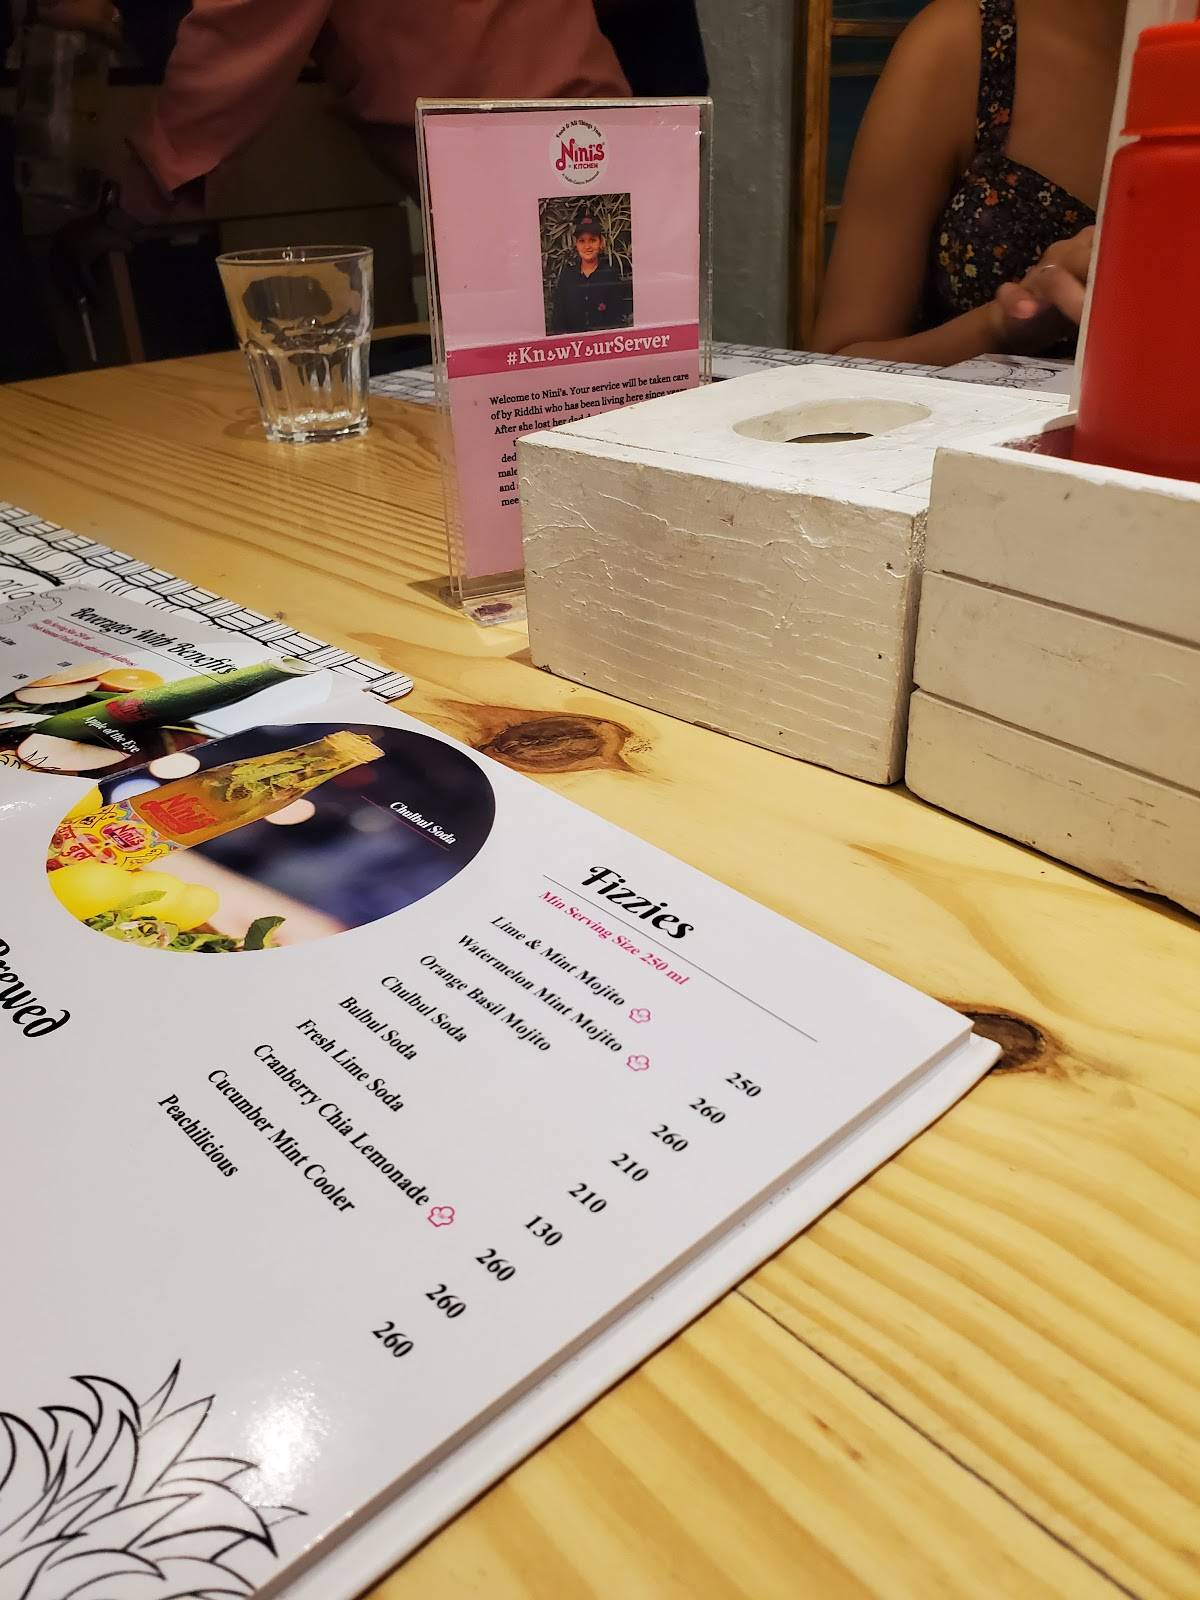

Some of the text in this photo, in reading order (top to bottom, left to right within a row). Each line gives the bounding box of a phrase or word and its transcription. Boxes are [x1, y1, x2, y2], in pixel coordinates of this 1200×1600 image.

[573, 162, 599, 170] KITCHEN
[489, 393, 530, 406] Welcome
[531, 392, 541, 401] to
[570, 385, 590, 396] Your
[591, 381, 621, 393] service
[621, 378, 637, 389] will
[638, 377, 648, 387] be
[649, 374, 671, 385] taken
[672, 373, 689, 382] care
[490, 410, 501, 421] of
[501, 408, 513, 420] by
[514, 404, 543, 418] Riddhi
[545, 402, 563, 413] who
[564, 400, 579, 411] has
[580, 398, 600, 409] been
[601, 394, 625, 408] living
[626, 391, 644, 402] here
[645, 388, 666, 399] since
[494, 422, 517, 435] After
[518, 420, 534, 432] she
[534, 418, 551, 430] lost
[552, 416, 567, 427] her
[500, 483, 516, 493] and
[71, 607, 138, 633] Beverages
[132, 629, 178, 648] With
[167, 642, 238, 675] Benefits
[390, 802, 457, 844] Chulbul Soda
[581, 866, 694, 939] Fizzies
[538, 890, 691, 987] Min Serving Size 250 ml
[490, 916, 625, 1007] Lime & Mint Mojito
[381, 975, 468, 1044] Chulbul Soda
[420, 955, 551, 1052] Orange Basil Mojito
[458, 934, 623, 1053] Watermelon Mint Mojito
[338, 996, 418, 1061] Bulbul Soda
[296, 1018, 405, 1112] Fresh Lime Soda
[725, 1072, 762, 1098] 250
[253, 1044, 430, 1207] Cranberry Chia Lemonade
[689, 1098, 726, 1125] 260
[158, 1094, 239, 1178] Peachilicious
[208, 1069, 356, 1213] Cucumber Mint Cooler
[651, 1124, 689, 1153] 260
[611, 1153, 649, 1182] 210
[568, 1183, 607, 1214] 210
[524, 1215, 563, 1247] 130
[475, 1248, 516, 1282] 260
[425, 1284, 467, 1319] 260
[372, 1321, 414, 1359] 260
